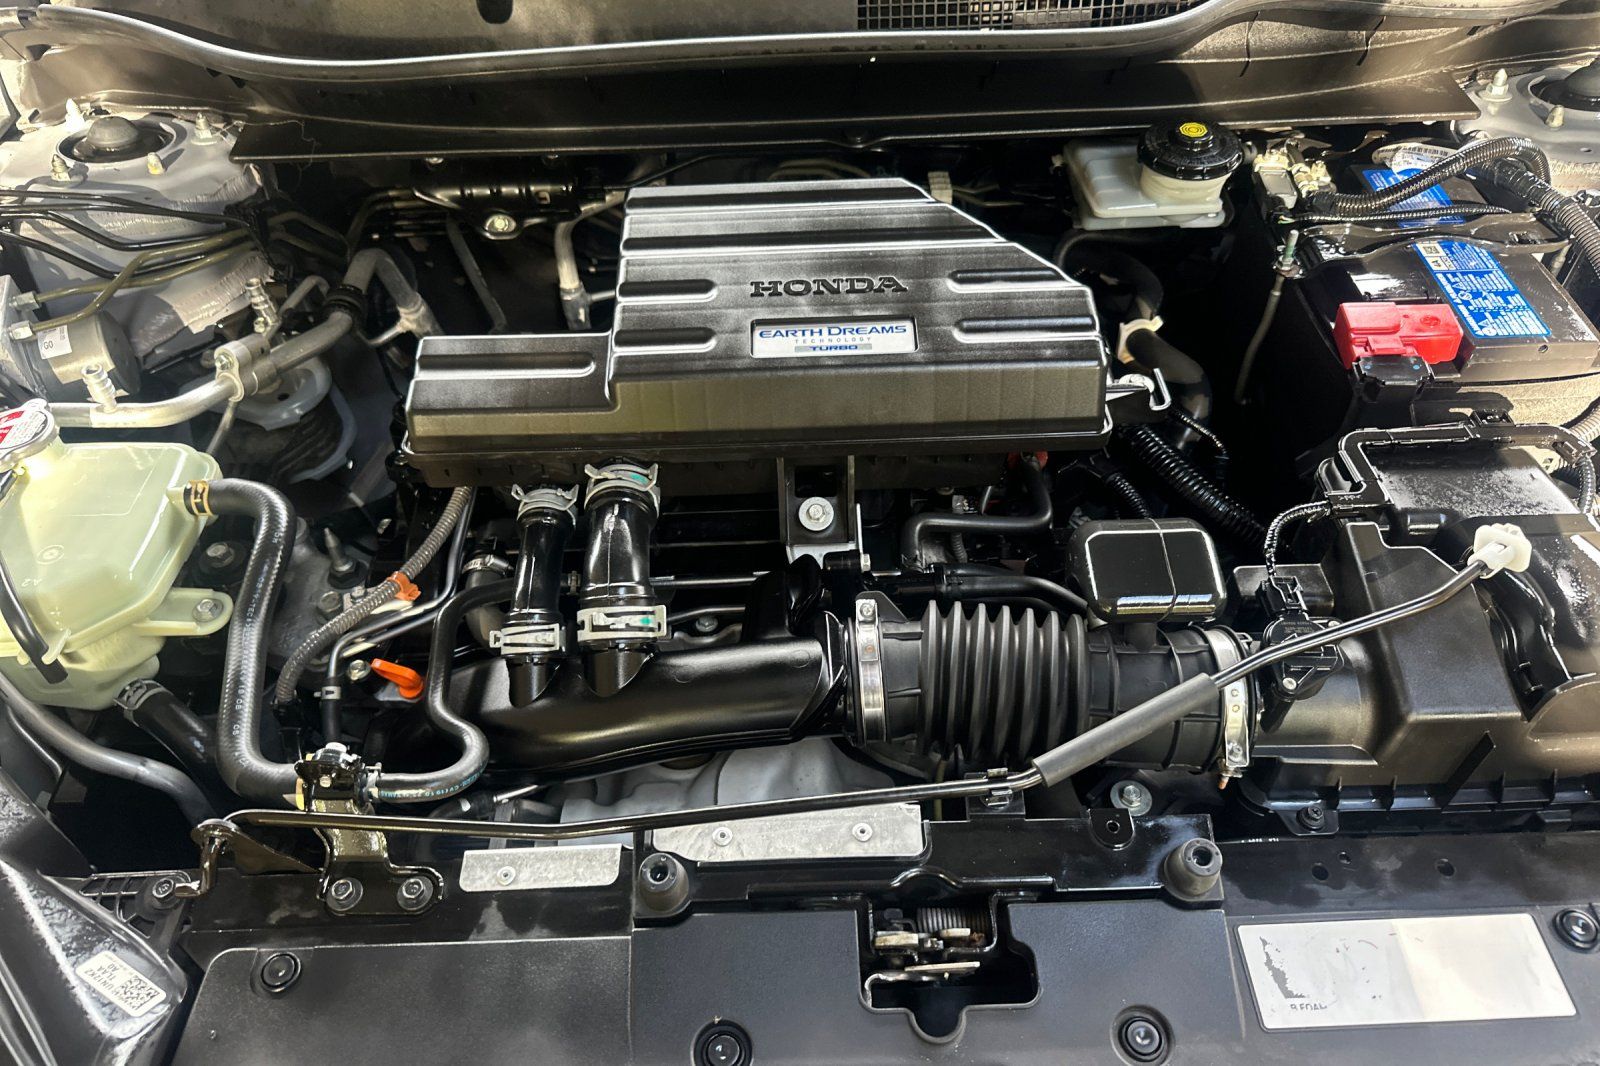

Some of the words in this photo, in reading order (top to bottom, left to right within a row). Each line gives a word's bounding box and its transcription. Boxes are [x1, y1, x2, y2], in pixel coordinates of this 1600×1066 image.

[750, 276, 908, 297] HONDA
[759, 328, 823, 338] EARTH
[827, 325, 907, 336] DREAMS
[795, 336, 871, 344] TECHNOLOGY
